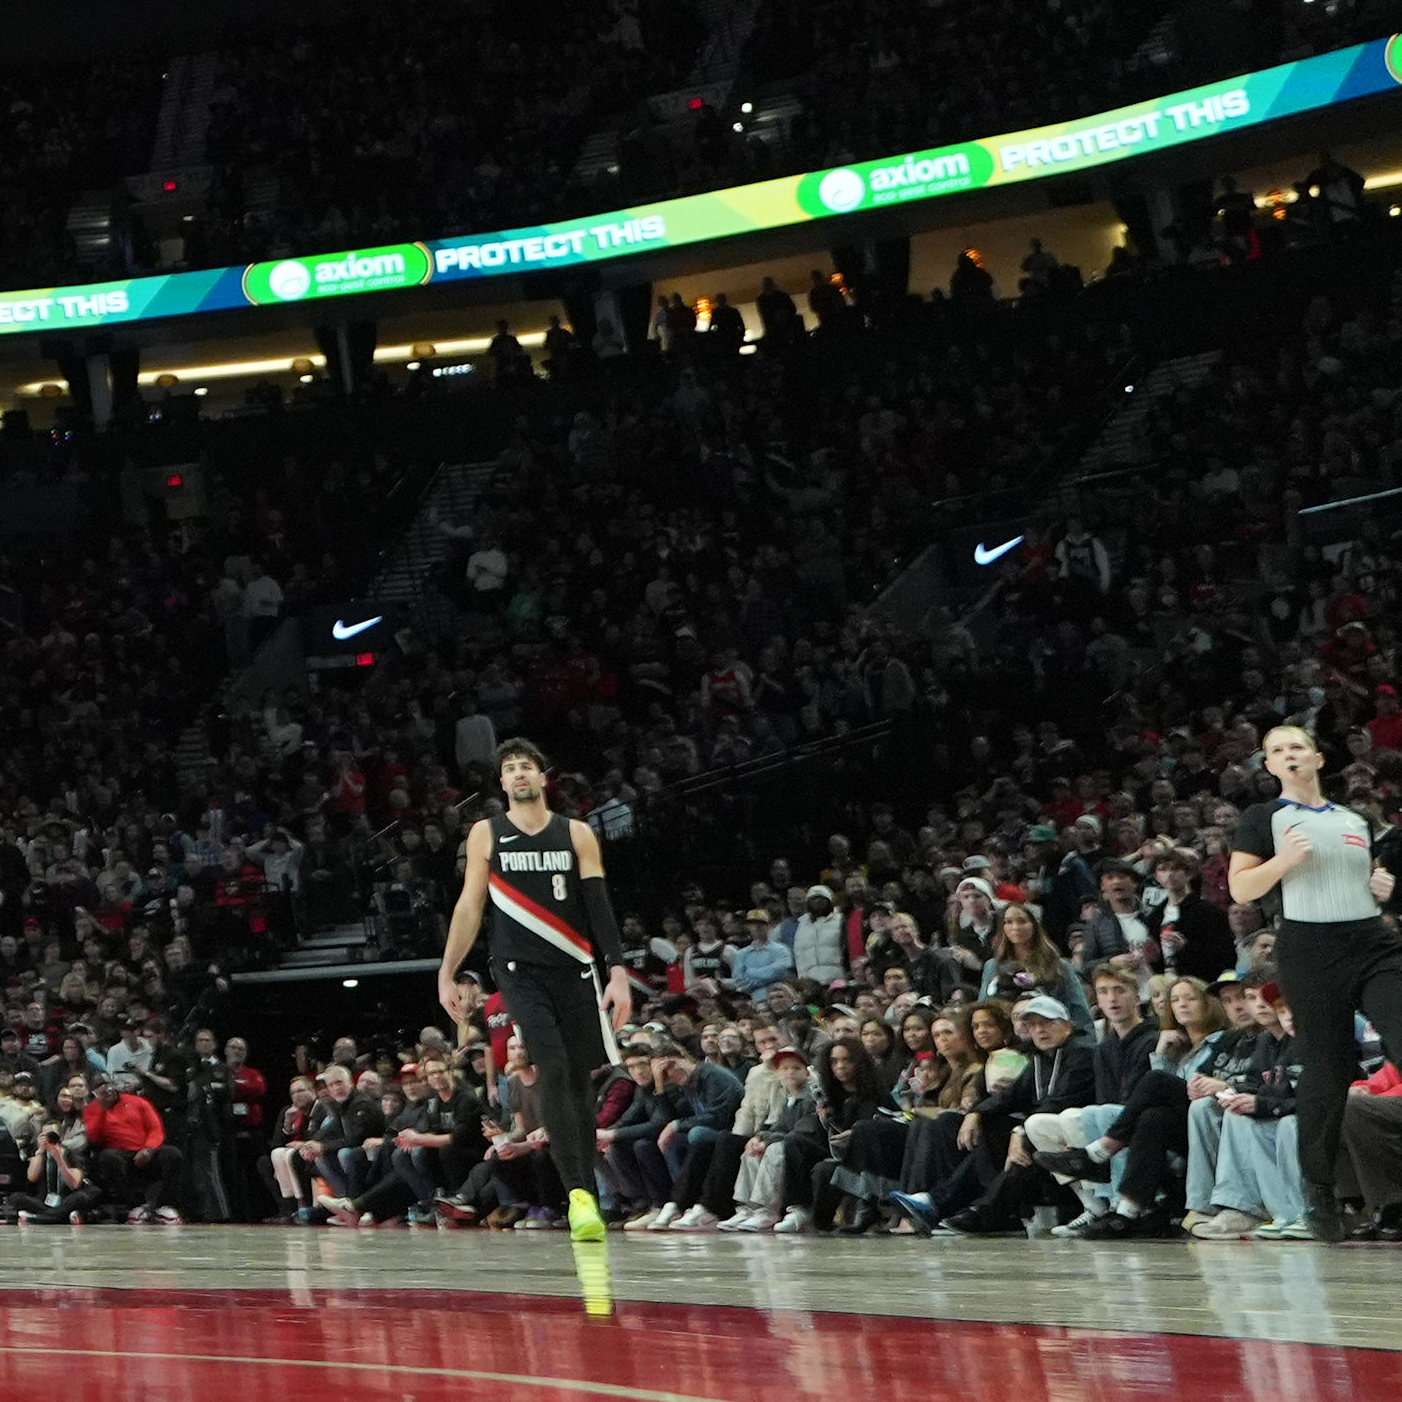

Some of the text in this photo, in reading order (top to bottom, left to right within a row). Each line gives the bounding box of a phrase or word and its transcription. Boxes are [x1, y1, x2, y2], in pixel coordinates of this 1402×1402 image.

[870, 151, 970, 190] axiom
[1000, 112, 1162, 172] PROTECT
[1166, 89, 1251, 132] THIS
[435, 215, 666, 273] PROTECT THIS
[315, 252, 404, 281] axiom
[55, 291, 129, 318] THIS
[499, 851, 572, 872] PORTLAND
[552, 874, 567, 901] 8
